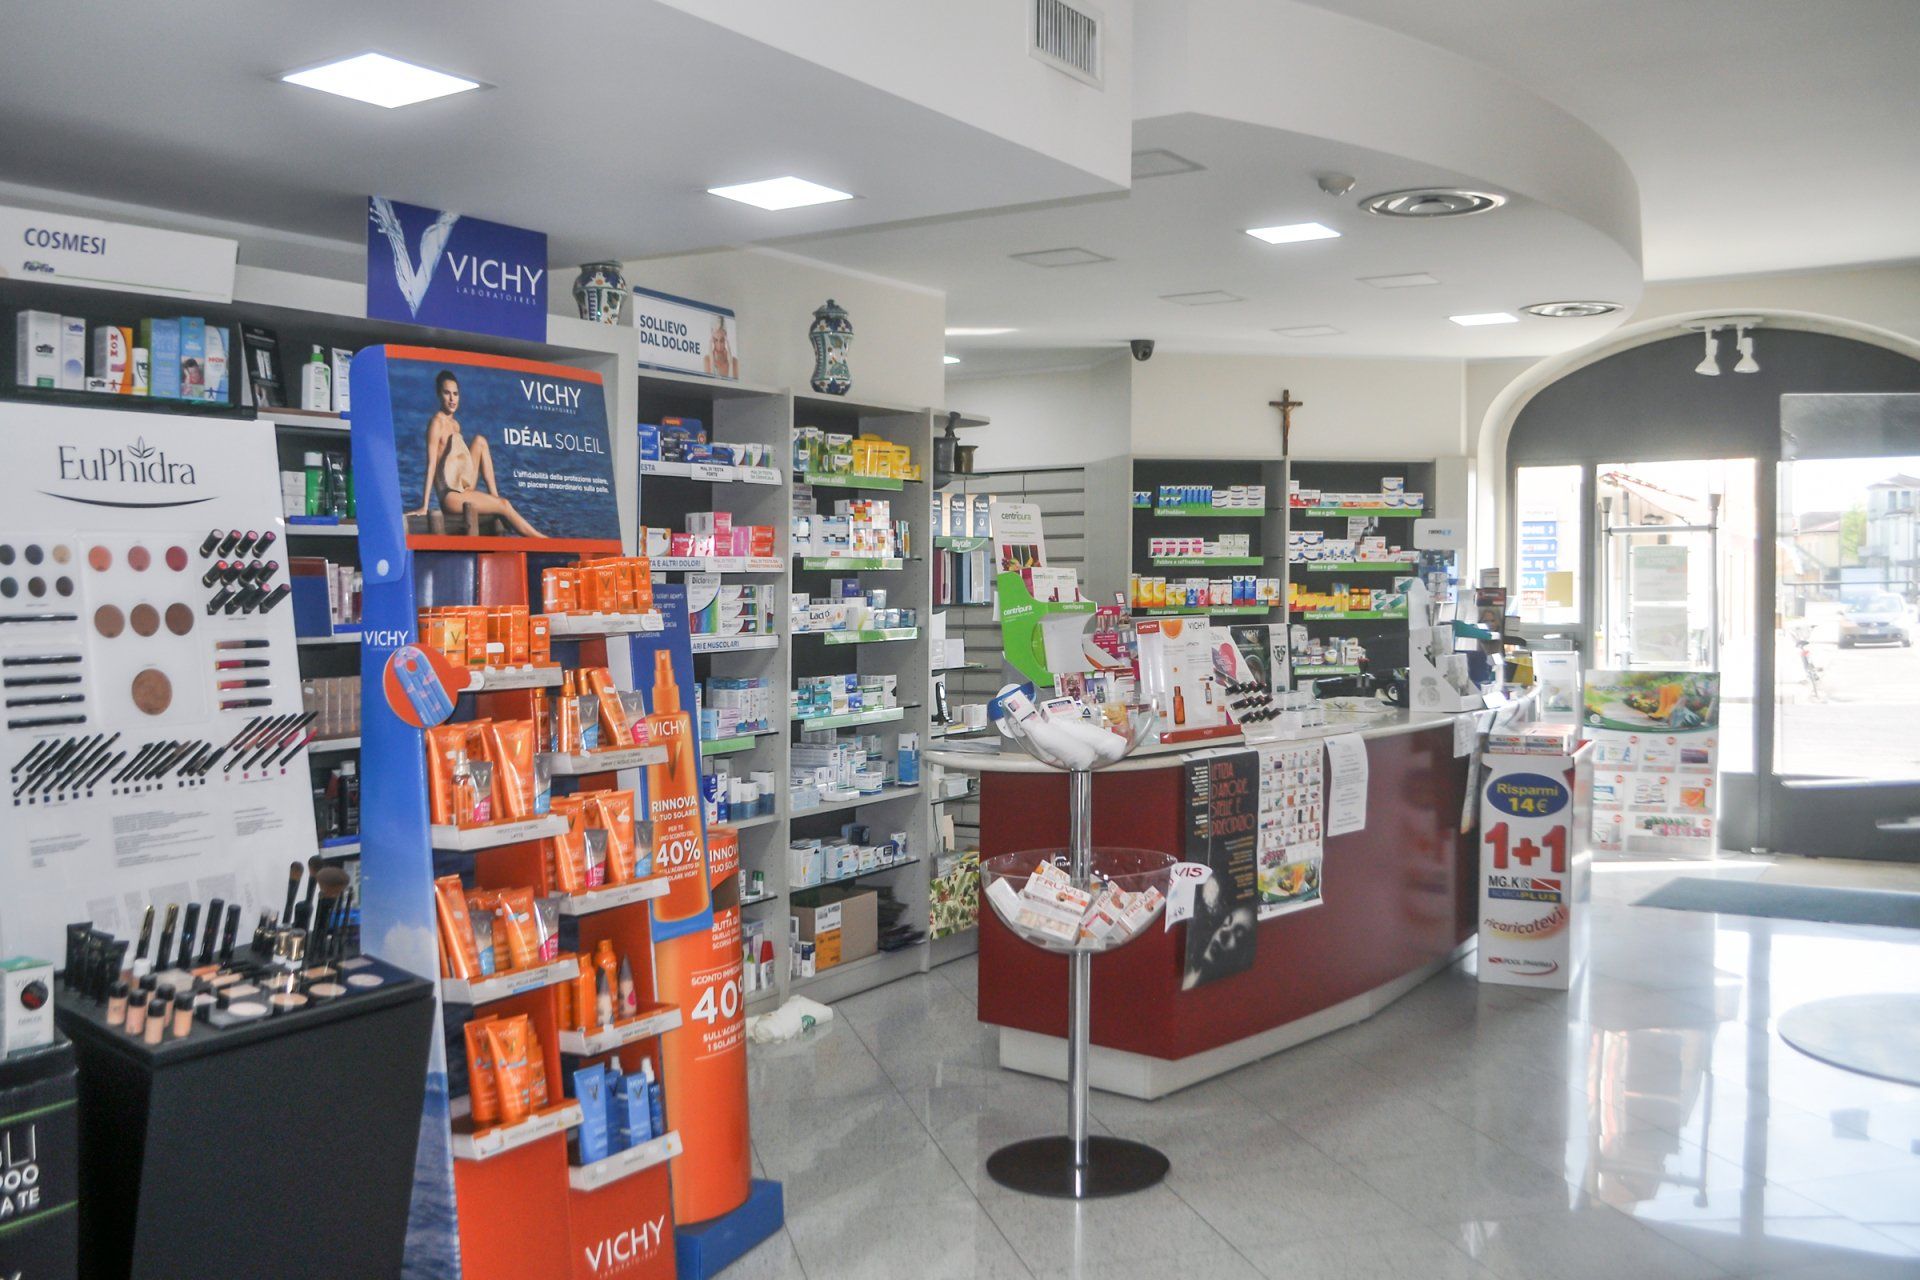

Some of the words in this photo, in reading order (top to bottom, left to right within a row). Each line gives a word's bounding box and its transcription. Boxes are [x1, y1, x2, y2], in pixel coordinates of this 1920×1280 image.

[24, 227, 107, 256] COSMESI
[446, 251, 543, 296] VICHY
[456, 286, 537, 306] LABORATOIRES
[640, 314, 687, 337] SOLLIEVO
[640, 331, 660, 347] DAL
[662, 335, 701, 355] DOLORE
[520, 379, 582, 409] VICHY
[503, 426, 553, 448] IDÉAL
[555, 433, 605, 455] SOLEIL
[58, 444, 196, 486] EuPhidra
[640, 463, 656, 472] ESTA
[662, 559, 678, 567] ALTRI
[1187, 622, 1206, 631] VICHY
[364, 630, 408, 646] VICHY
[708, 640, 740, 649] MUSCOLARI
[650, 719, 687, 737] VICHY
[1496, 783, 1559, 798] Risparmi
[652, 795, 698, 813] RINNOVA
[1508, 797, 1548, 814] 14€
[661, 812, 672, 822] TUO
[656, 838, 701, 867] 40%
[709, 844, 738, 862] INNOV
[1484, 821, 1566, 874] 1+1
[710, 863, 724, 874] TUO
[1174, 867, 1203, 878] VIS
[1035, 876, 1084, 899] FRUVIS
[1520, 891, 1558, 902] PLUS
[712, 920, 732, 933] BUTTA
[1484, 906, 1565, 934] ricaricatevi
[691, 972, 722, 986] SCONTO
[0, 1163, 40, 1192] OO
[584, 1214, 666, 1272] VICHY
